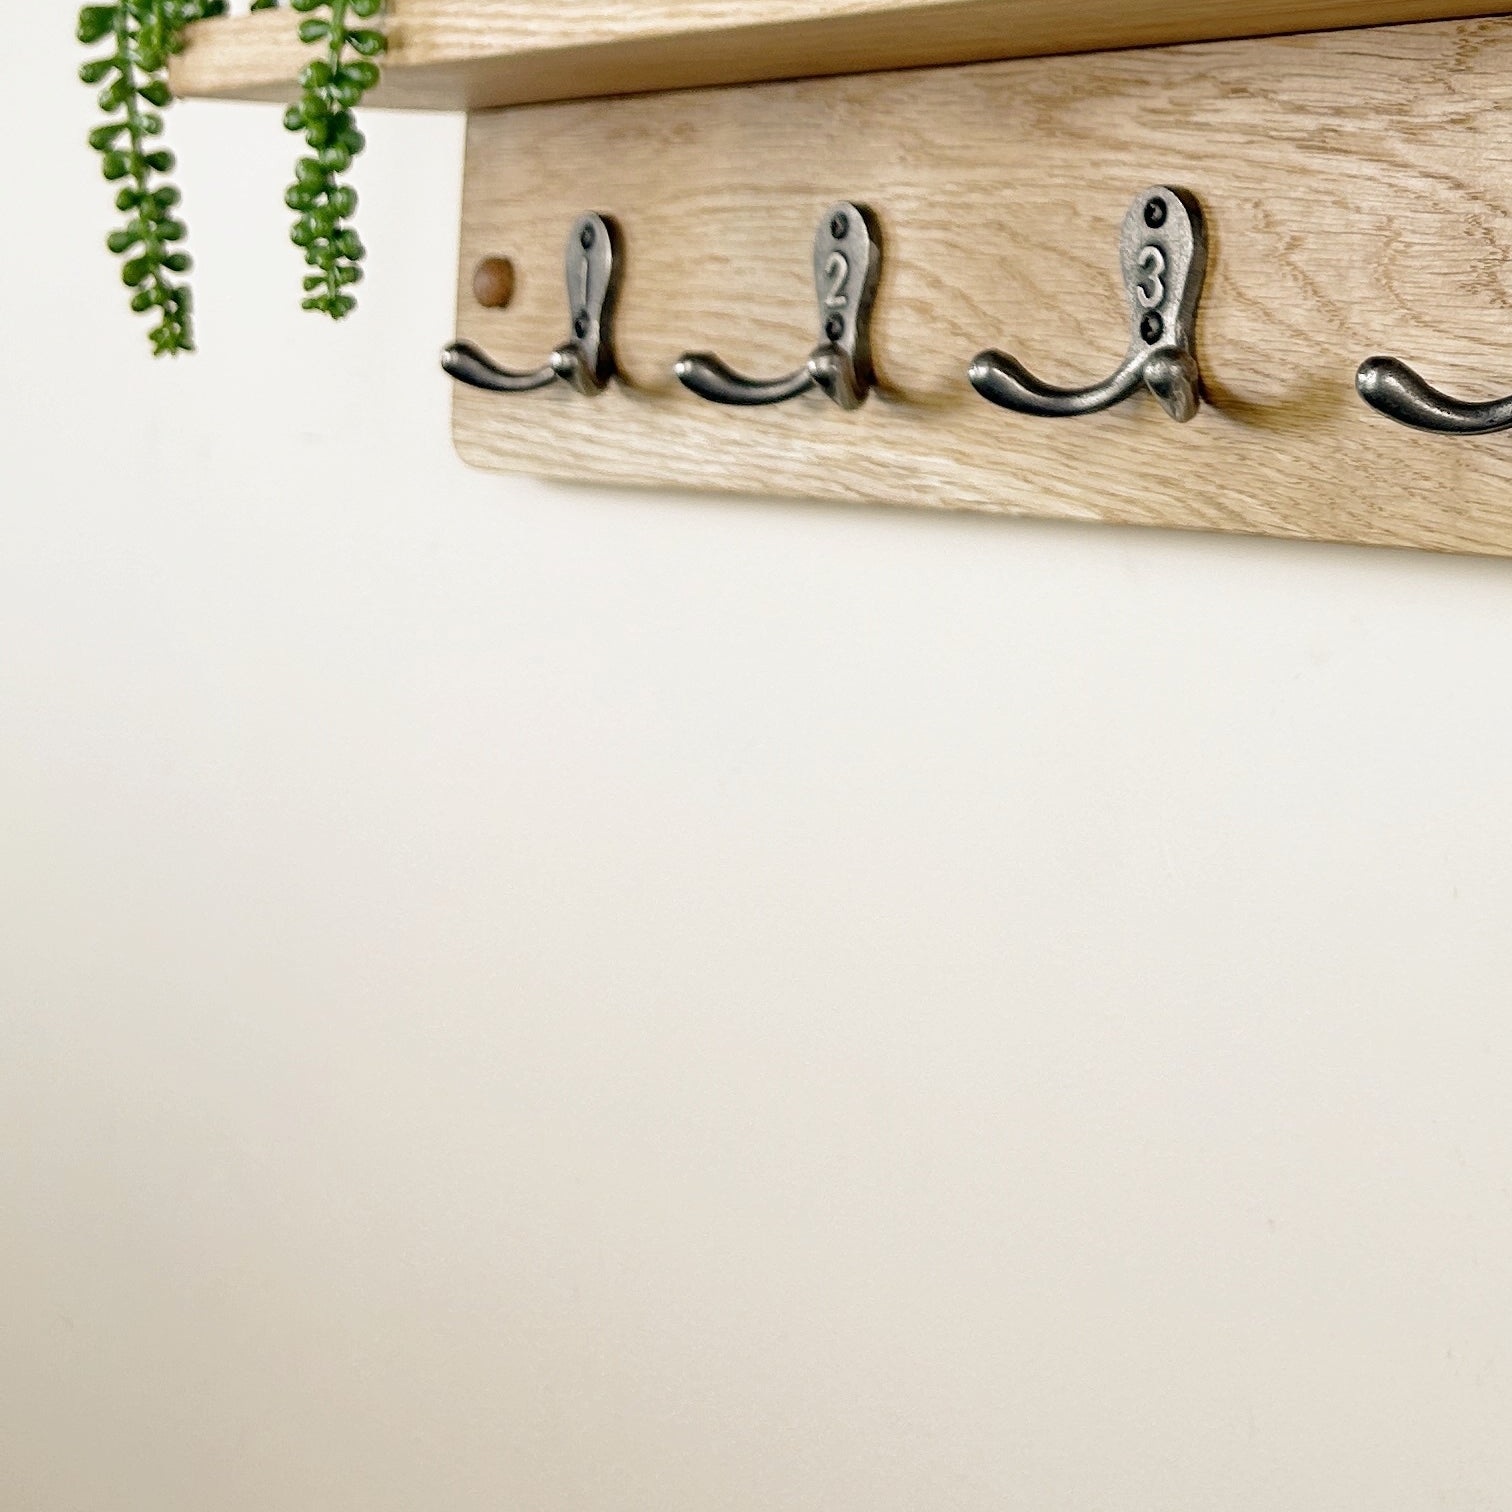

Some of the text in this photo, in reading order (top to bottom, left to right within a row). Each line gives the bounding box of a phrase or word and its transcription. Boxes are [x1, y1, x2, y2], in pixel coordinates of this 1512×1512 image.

[577, 256, 590, 306] 1
[822, 251, 848, 306] 2
[1135, 244, 1166, 308] 3
